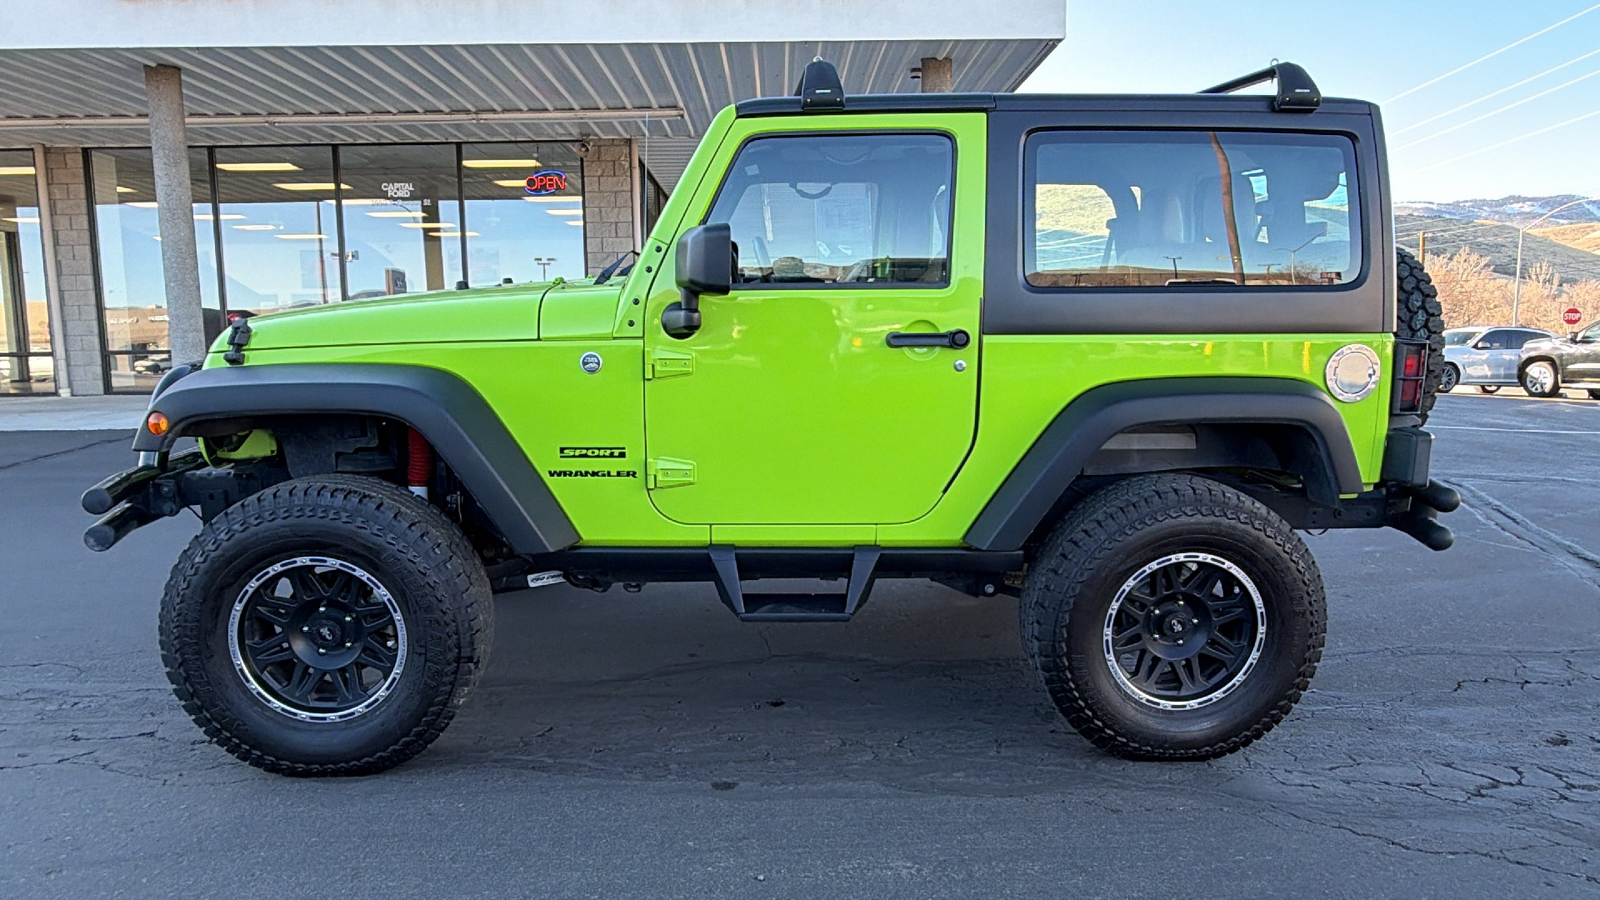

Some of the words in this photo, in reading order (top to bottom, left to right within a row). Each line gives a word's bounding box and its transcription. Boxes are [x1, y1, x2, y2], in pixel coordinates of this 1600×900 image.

[381, 182, 414, 190] CAPITAL
[526, 176, 566, 190] OPEN
[387, 190, 410, 198] FORD
[1564, 312, 1580, 320] STOP
[560, 448, 625, 457] SPORT
[547, 470, 638, 478] WRANGLER
